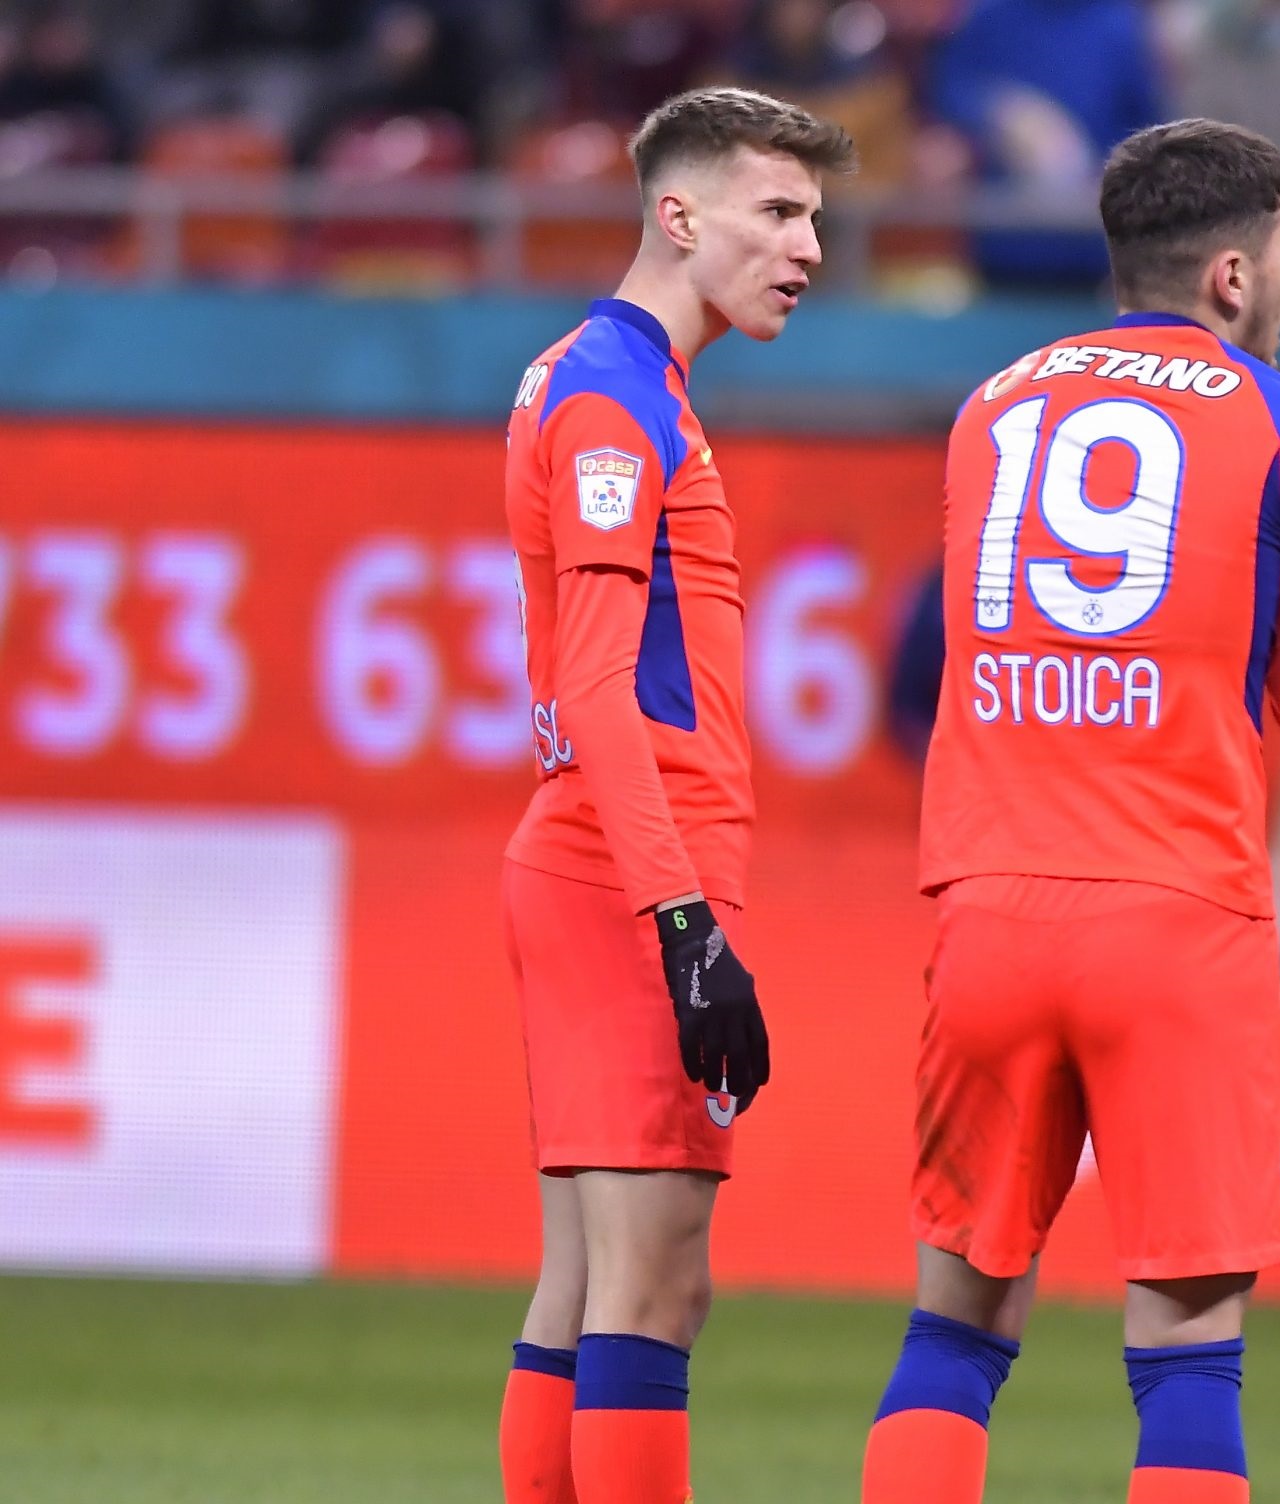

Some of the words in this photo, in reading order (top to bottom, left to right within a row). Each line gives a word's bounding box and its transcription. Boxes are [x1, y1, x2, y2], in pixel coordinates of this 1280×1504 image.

[1031, 345, 1241, 398] BETANO
[587, 502, 618, 514] LIGA
[975, 392, 1187, 639] 19
[0, 531, 253, 762] 33
[973, 652, 1161, 727] STOICA
[672, 910, 688, 930] 6
